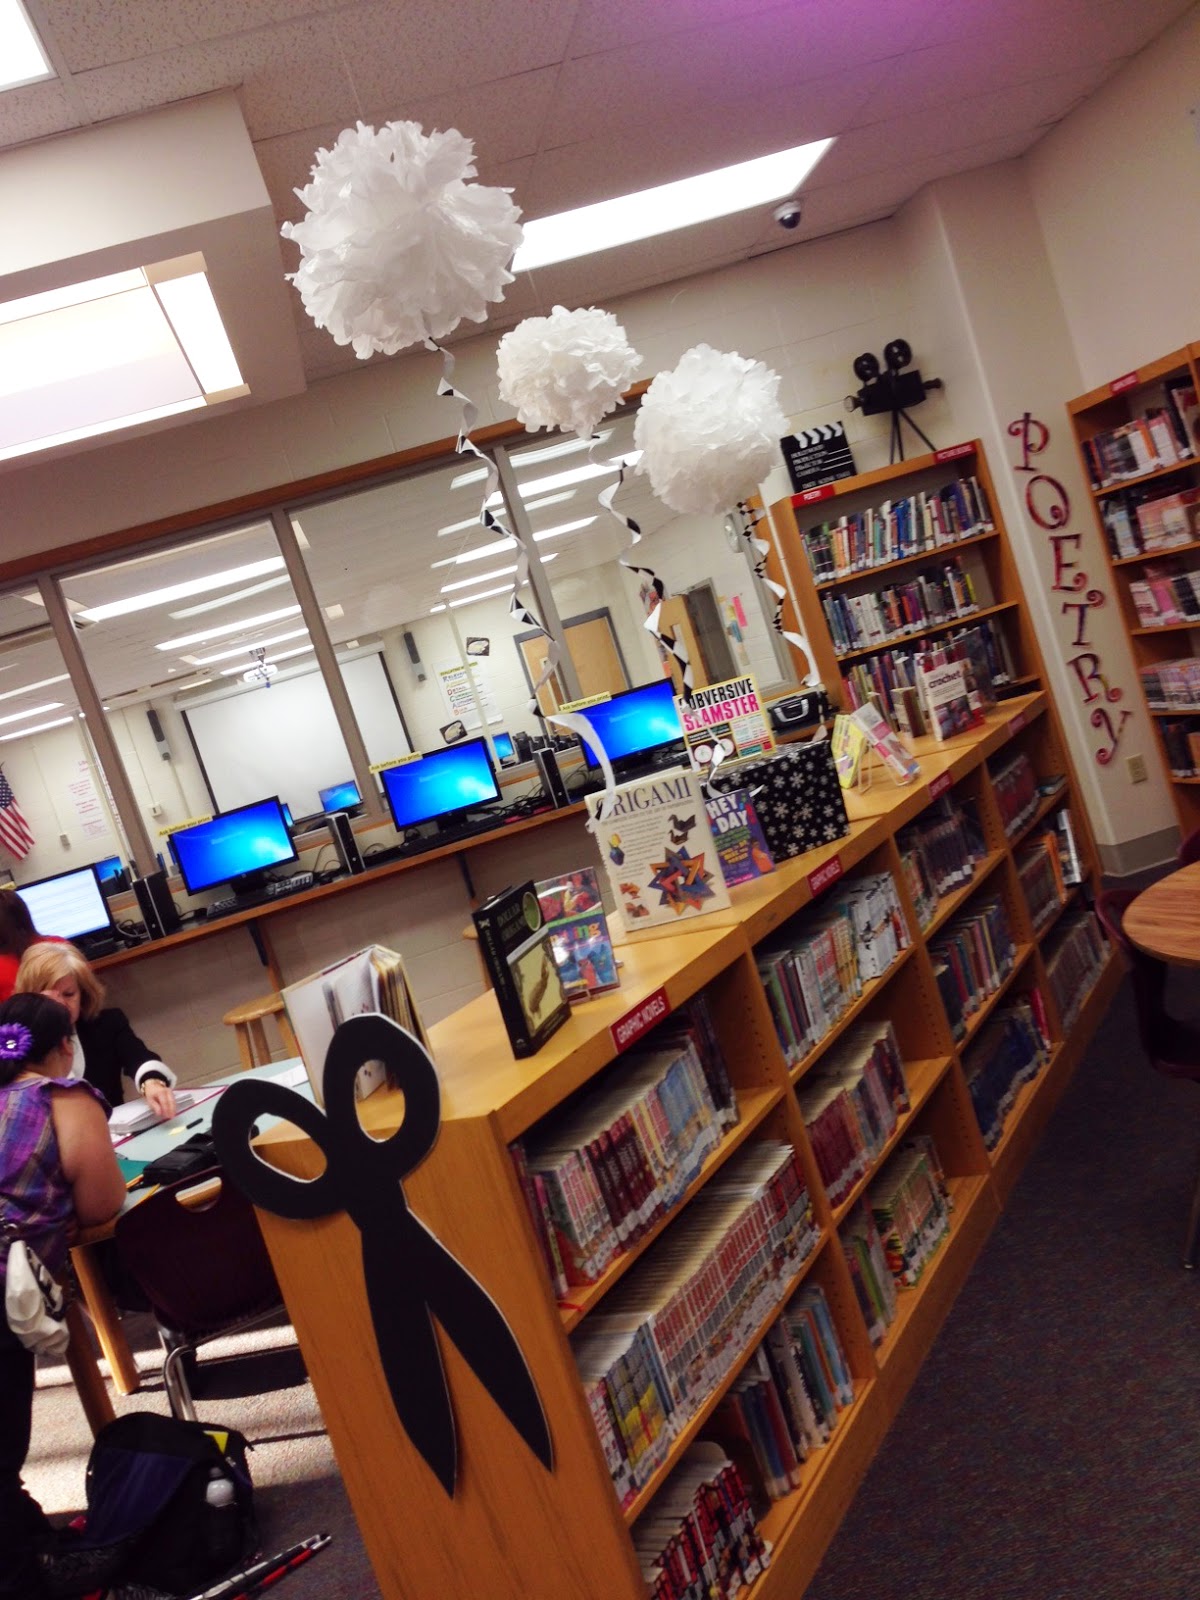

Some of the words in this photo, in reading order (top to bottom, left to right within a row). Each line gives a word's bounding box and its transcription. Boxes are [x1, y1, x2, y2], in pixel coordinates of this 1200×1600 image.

[1007, 412, 1132, 765] POETRY
[929, 670, 961, 688] crochet
[679, 678, 754, 710] UBVERSIVE
[705, 793, 738, 820] HEY
[715, 810, 748, 833] DAY
[616, 1012, 644, 1044] GRAPHIC
[641, 995, 666, 1024] NOVELS
